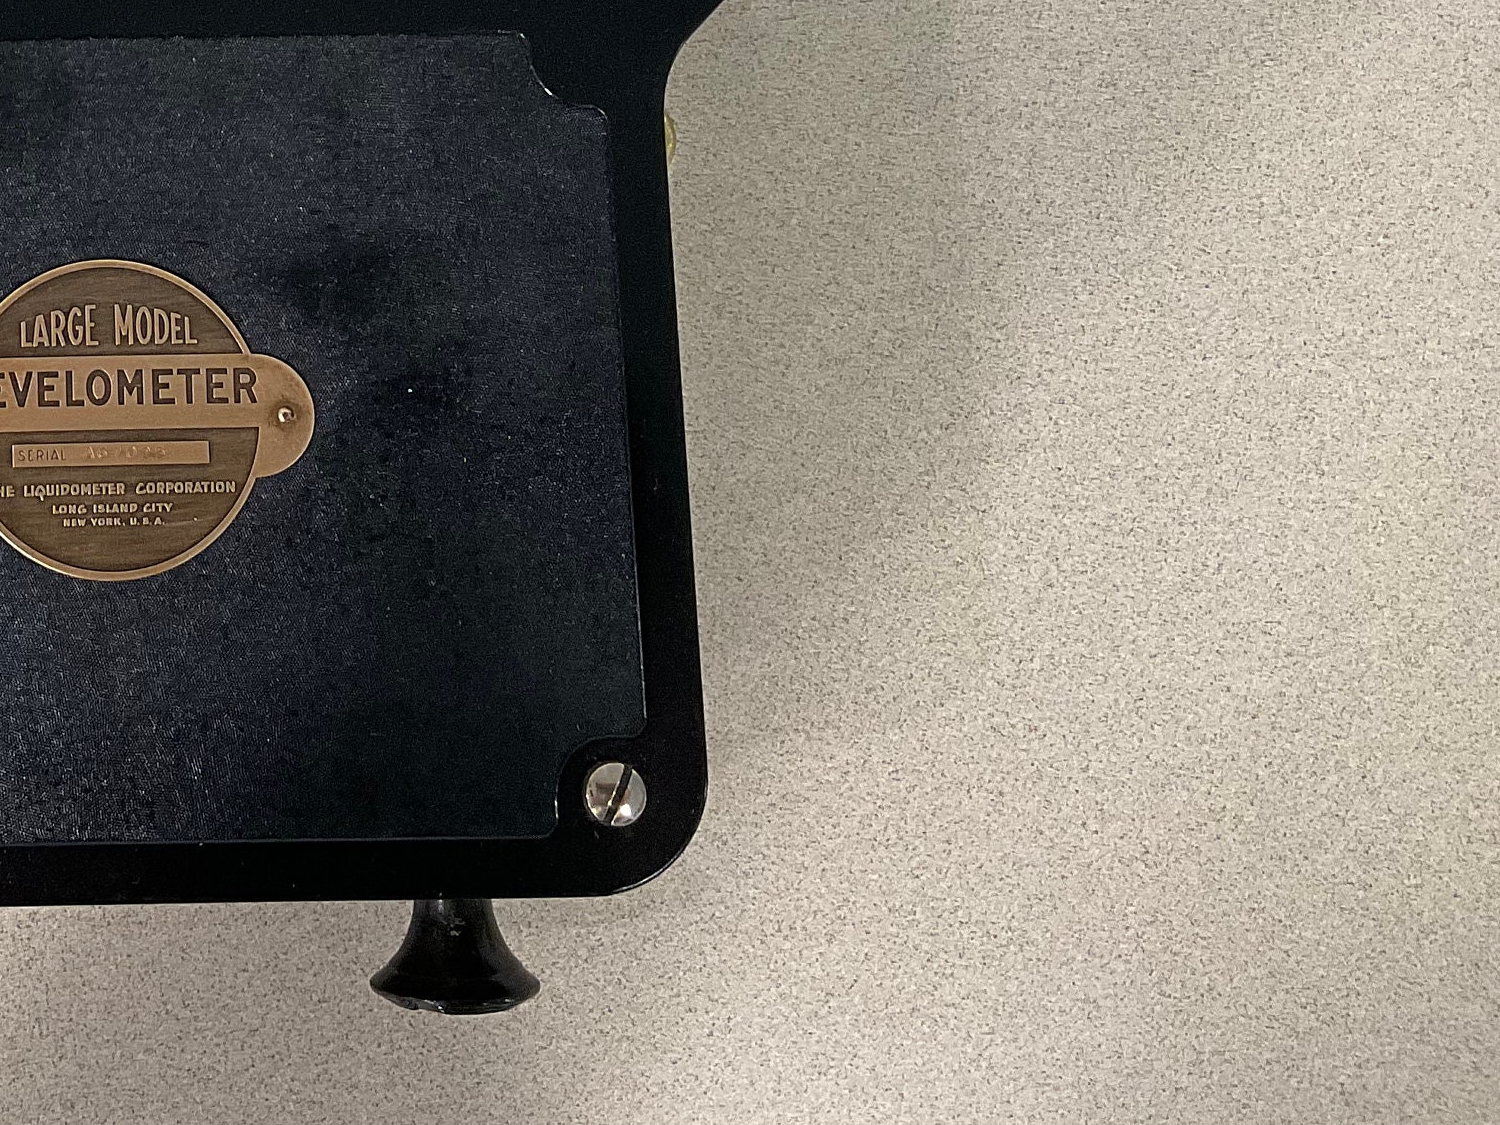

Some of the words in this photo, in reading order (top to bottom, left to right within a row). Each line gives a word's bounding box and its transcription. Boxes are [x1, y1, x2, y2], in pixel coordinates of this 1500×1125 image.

[19, 304, 99, 349] LARGE
[114, 303, 199, 347] MODEL
[18, 448, 66, 463] SERIAL
[23, 483, 126, 502] LIQUIDOMETER
[135, 480, 237, 496] CORPORATION
[52, 503, 88, 516] LONG
[92, 502, 138, 515] ISLAND
[143, 501, 174, 514] CITY
[63, 518, 87, 528] NEW
